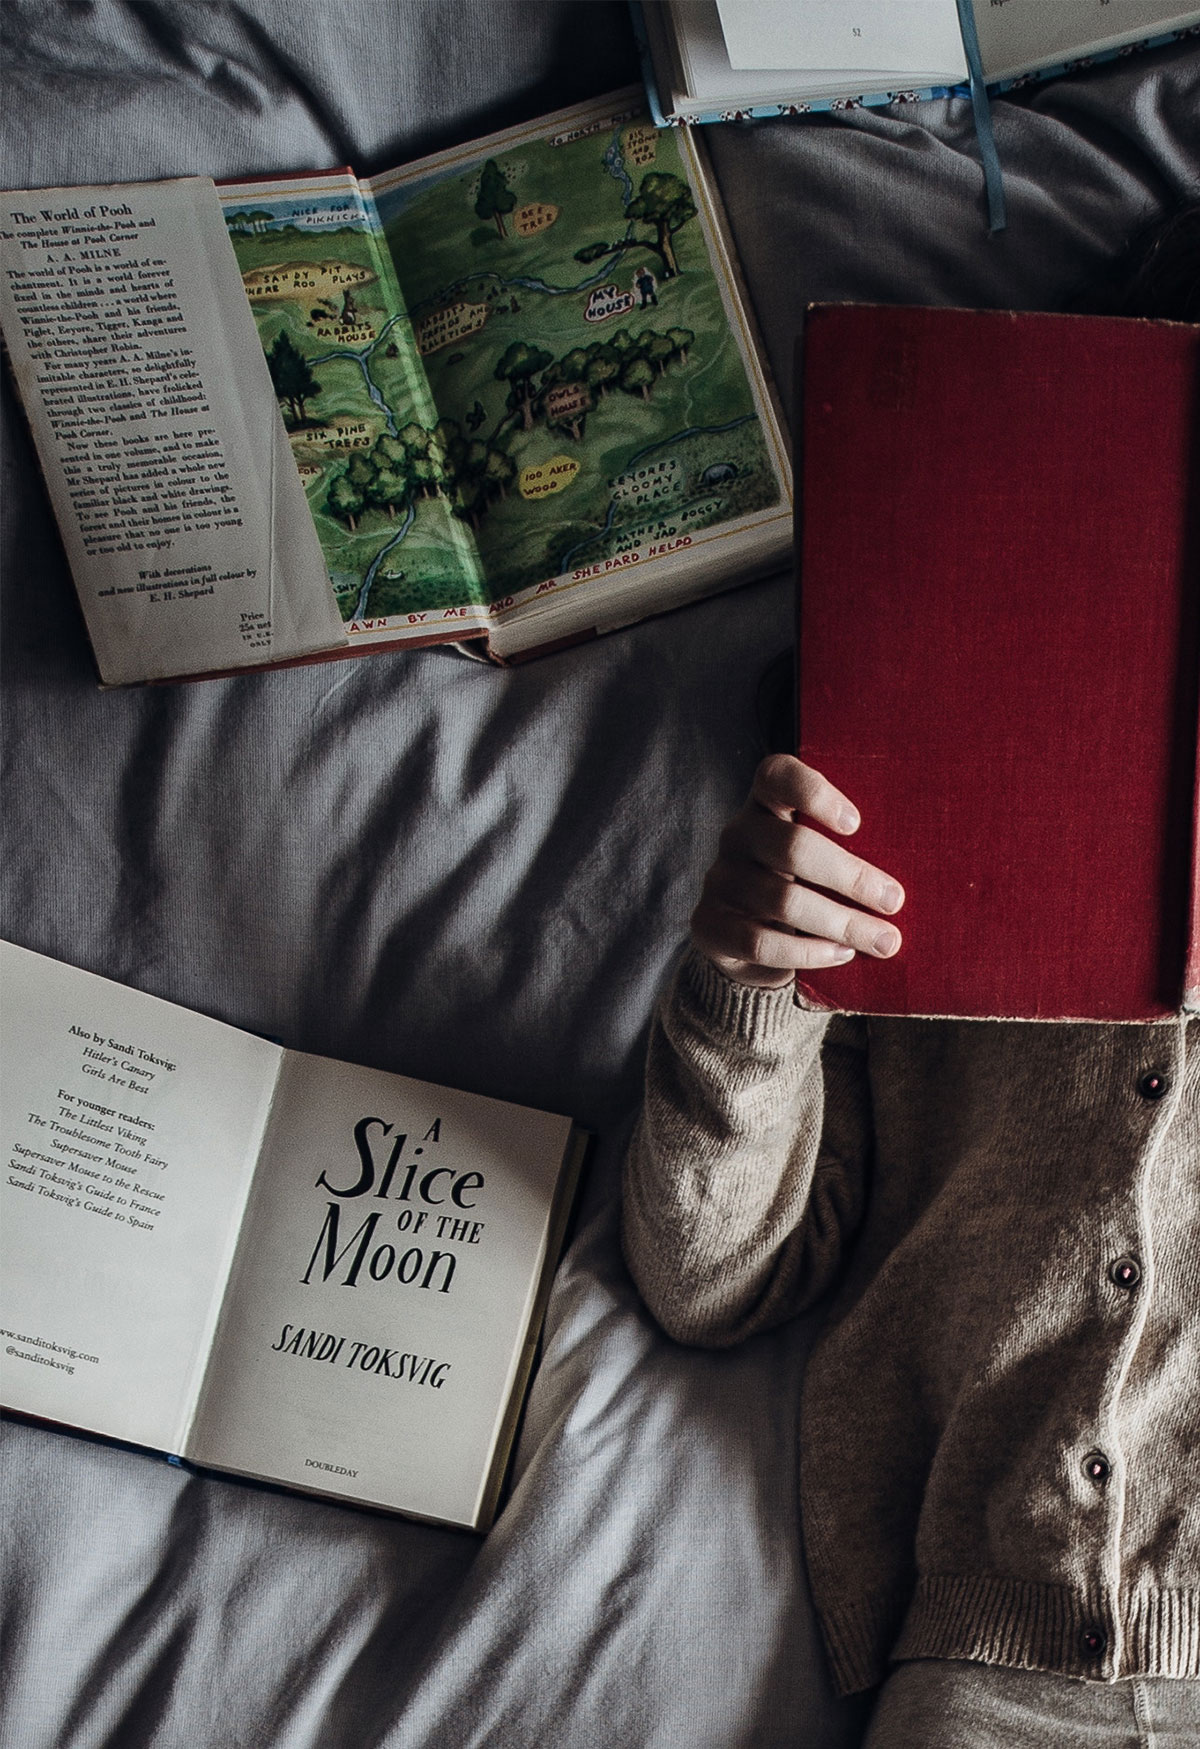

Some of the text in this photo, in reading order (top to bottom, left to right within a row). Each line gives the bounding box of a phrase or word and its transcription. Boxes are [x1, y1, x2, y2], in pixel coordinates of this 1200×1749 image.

[9, 203, 133, 225] The World of Pooh
[292, 204, 349, 217] NICE FOR
[520, 213, 553, 232] TREE
[16, 227, 59, 240] complete
[138, 217, 157, 228] and
[19, 240, 38, 250] The
[41, 239, 70, 249] House
[83, 234, 107, 245] Pooh
[108, 233, 139, 243] Corner
[46, 248, 122, 263] A. A. MILNE
[245, 284, 279, 296] HERE
[332, 271, 366, 284] PLAYS
[264, 265, 341, 283] SANDY PIT
[588, 296, 630, 318] HOUSE
[593, 287, 615, 303] MY
[317, 321, 372, 337] RABBITS
[338, 331, 376, 343] HOUSE
[306, 424, 366, 442] SIX PINE
[324, 437, 370, 449] TREES
[525, 463, 577, 481] 100 AKER
[523, 481, 557, 495] WOOD
[613, 474, 673, 501] GLOOMY
[637, 481, 681, 505] PLACE
[616, 521, 667, 544] RATHER
[616, 527, 676, 553] AND SAD
[407, 612, 428, 624] BY
[444, 607, 468, 618] ME
[489, 597, 514, 615] AND
[536, 580, 557, 594] MR
[649, 536, 692, 557] HELPD
[150, 585, 215, 603] E. H. Shepard
[240, 611, 265, 622] Price
[68, 1025, 177, 1072] Also by Sandi Toksvig:
[82, 1046, 156, 1081] Hitler's Canary
[81, 1063, 150, 1095] Girls Are Best
[57, 1088, 156, 1131] For younger readers:
[58, 1105, 148, 1147] The Littlest Viking
[422, 1117, 441, 1143] A
[28, 1112, 169, 1171] The Troublesome Tooth Fairy
[49, 1138, 138, 1175] Supersaver Mouse
[315, 1116, 486, 1209] Slice
[12, 1142, 166, 1201] Supersaver Mouse to the Rescue
[7, 1158, 161, 1217] Sandi Toksvig's Guide to France
[5, 1175, 155, 1231] Sandi Toksvig's Guide to Spain
[396, 1209, 485, 1245] OF THE
[299, 1201, 457, 1294] Moon
[5, 1345, 75, 1376] @sanditoksvig
[271, 1324, 452, 1389] SANDI TOKSVIG
[304, 1458, 359, 1478] DOUBLEDAY
